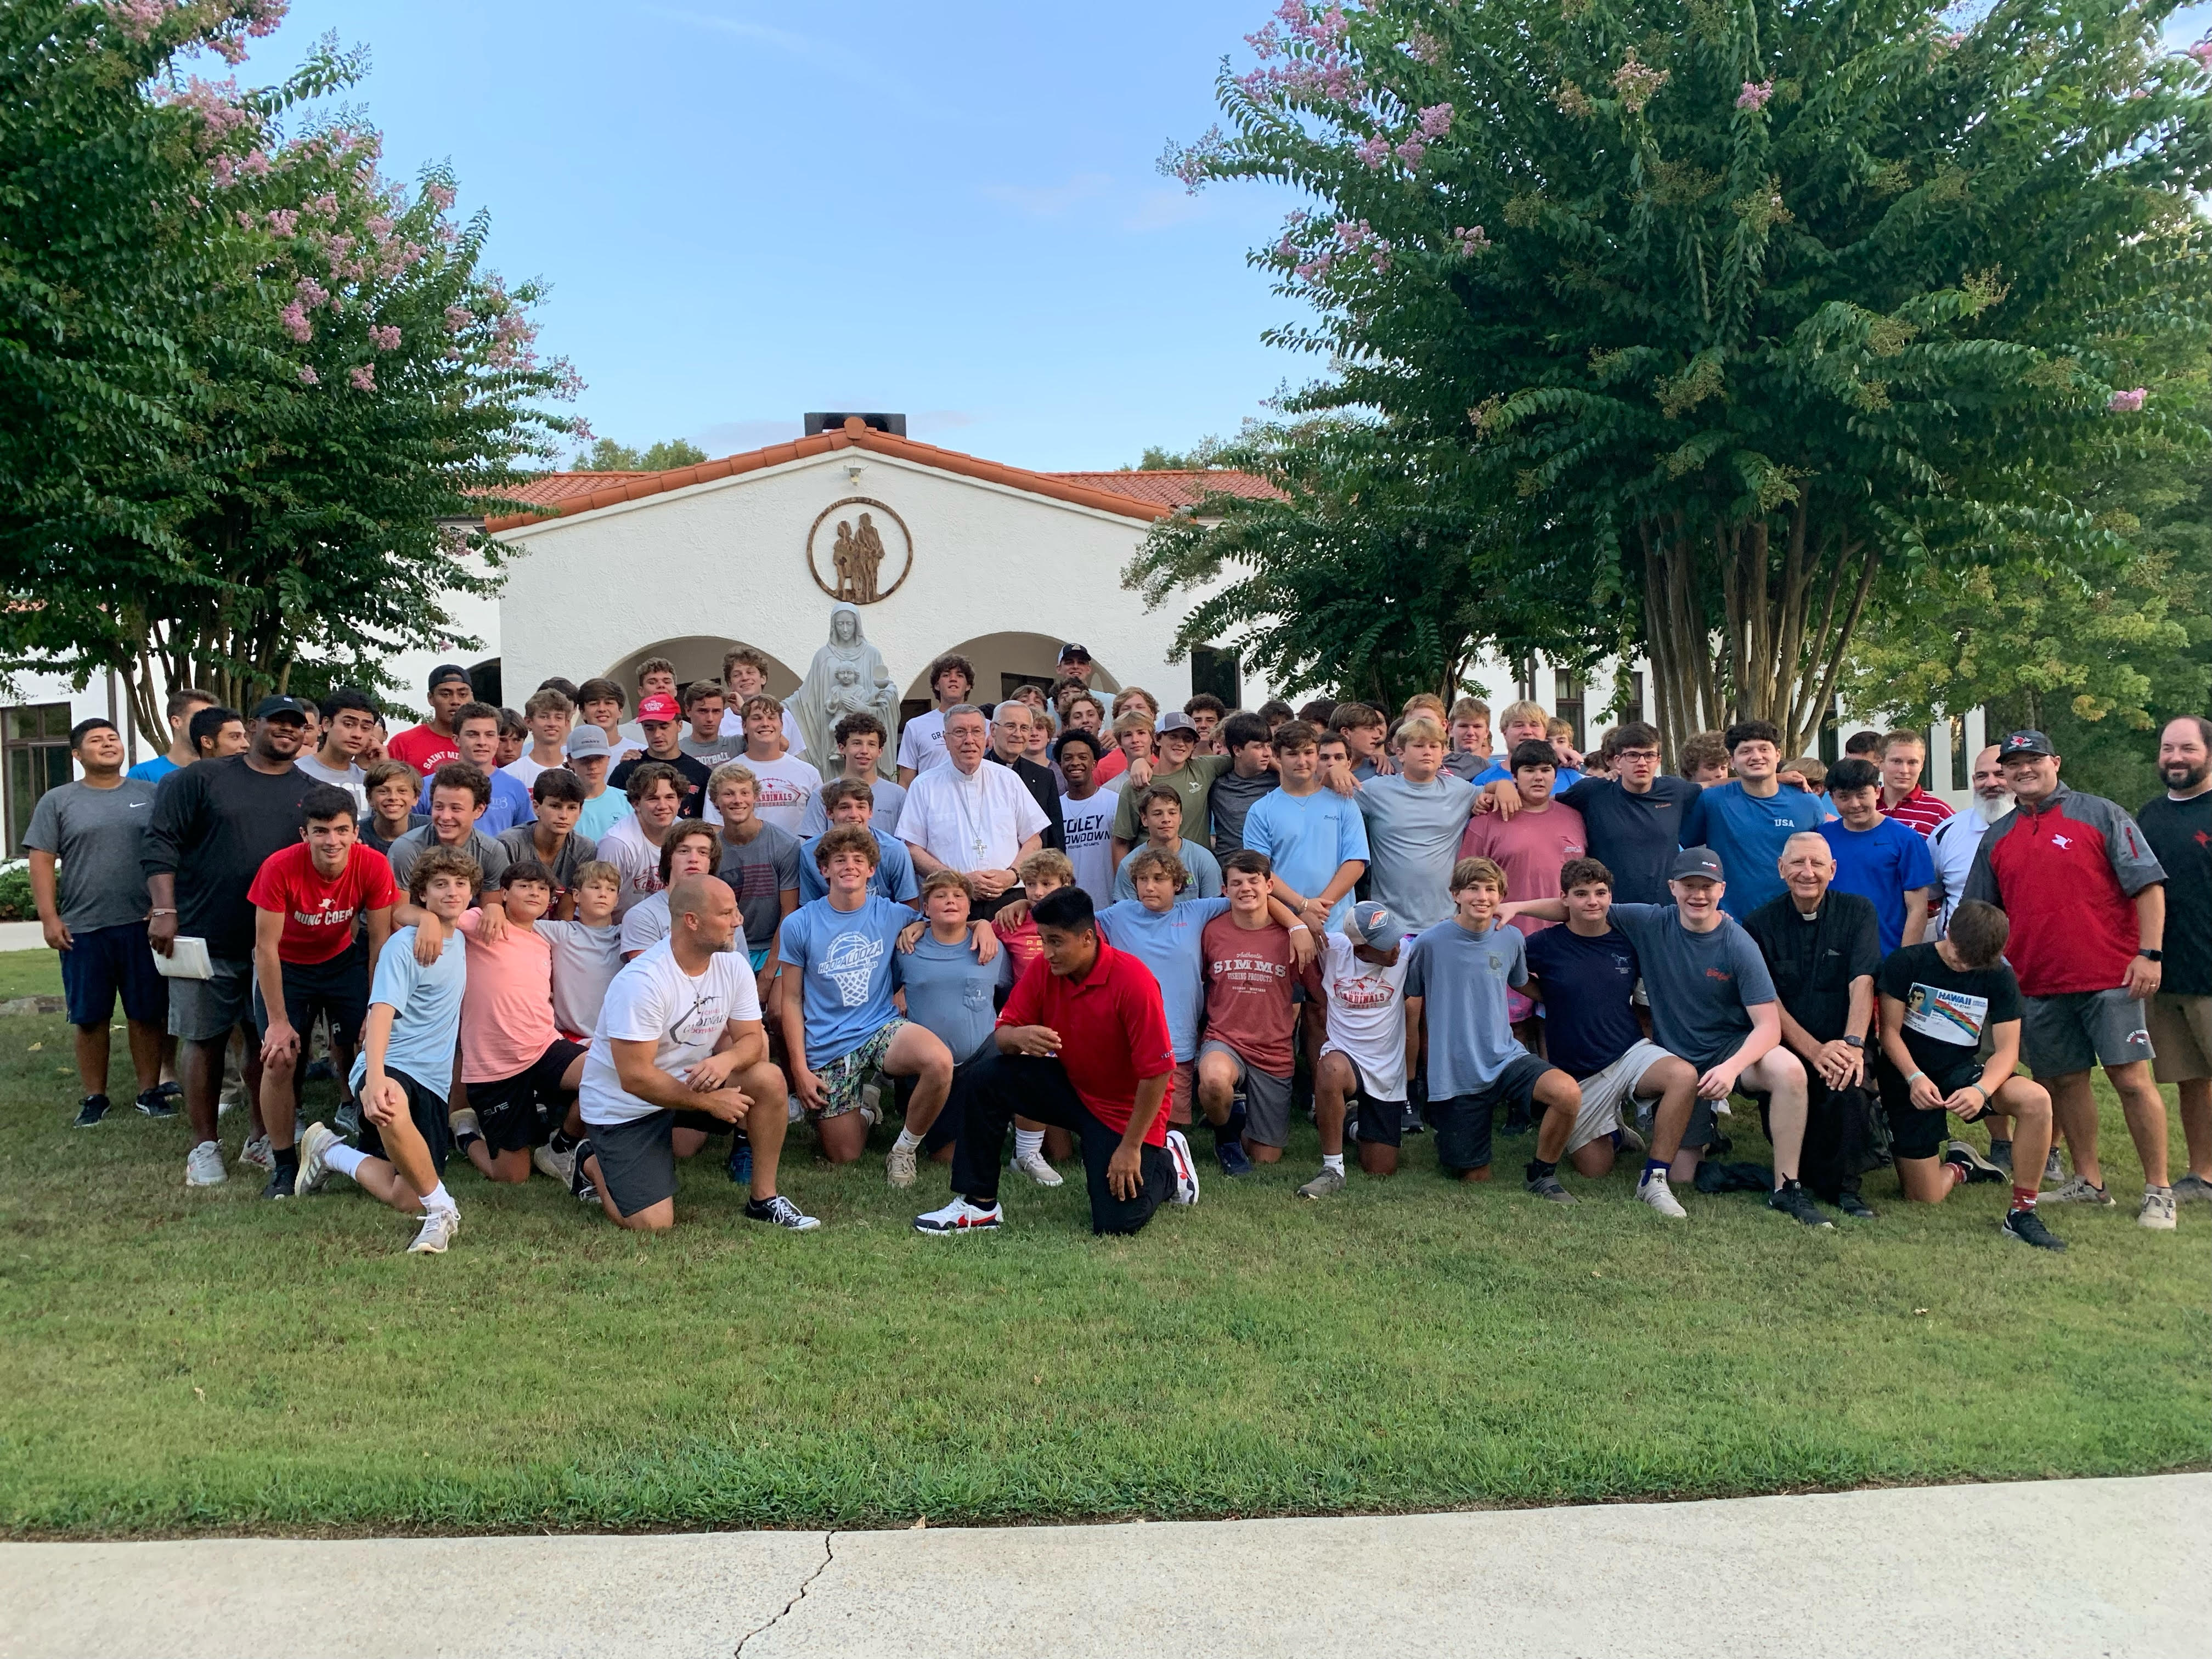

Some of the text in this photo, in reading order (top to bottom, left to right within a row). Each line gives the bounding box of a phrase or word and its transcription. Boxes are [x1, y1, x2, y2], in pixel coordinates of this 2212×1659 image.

[423, 751, 445, 769] SAINT
[695, 752, 731, 765] OOTBALL
[757, 793, 792, 802] RDINALS
[1774, 819, 1795, 828] USA
[1065, 831, 1110, 844] OWDOWN
[294, 910, 323, 926] NUNC
[819, 943, 882, 973] HOOPALOOZA
[1214, 959, 1286, 978] SIMMS
[1227, 972, 1272, 983] FISHING PRODUCTS
[1938, 991, 1972, 1006] HAWAII
